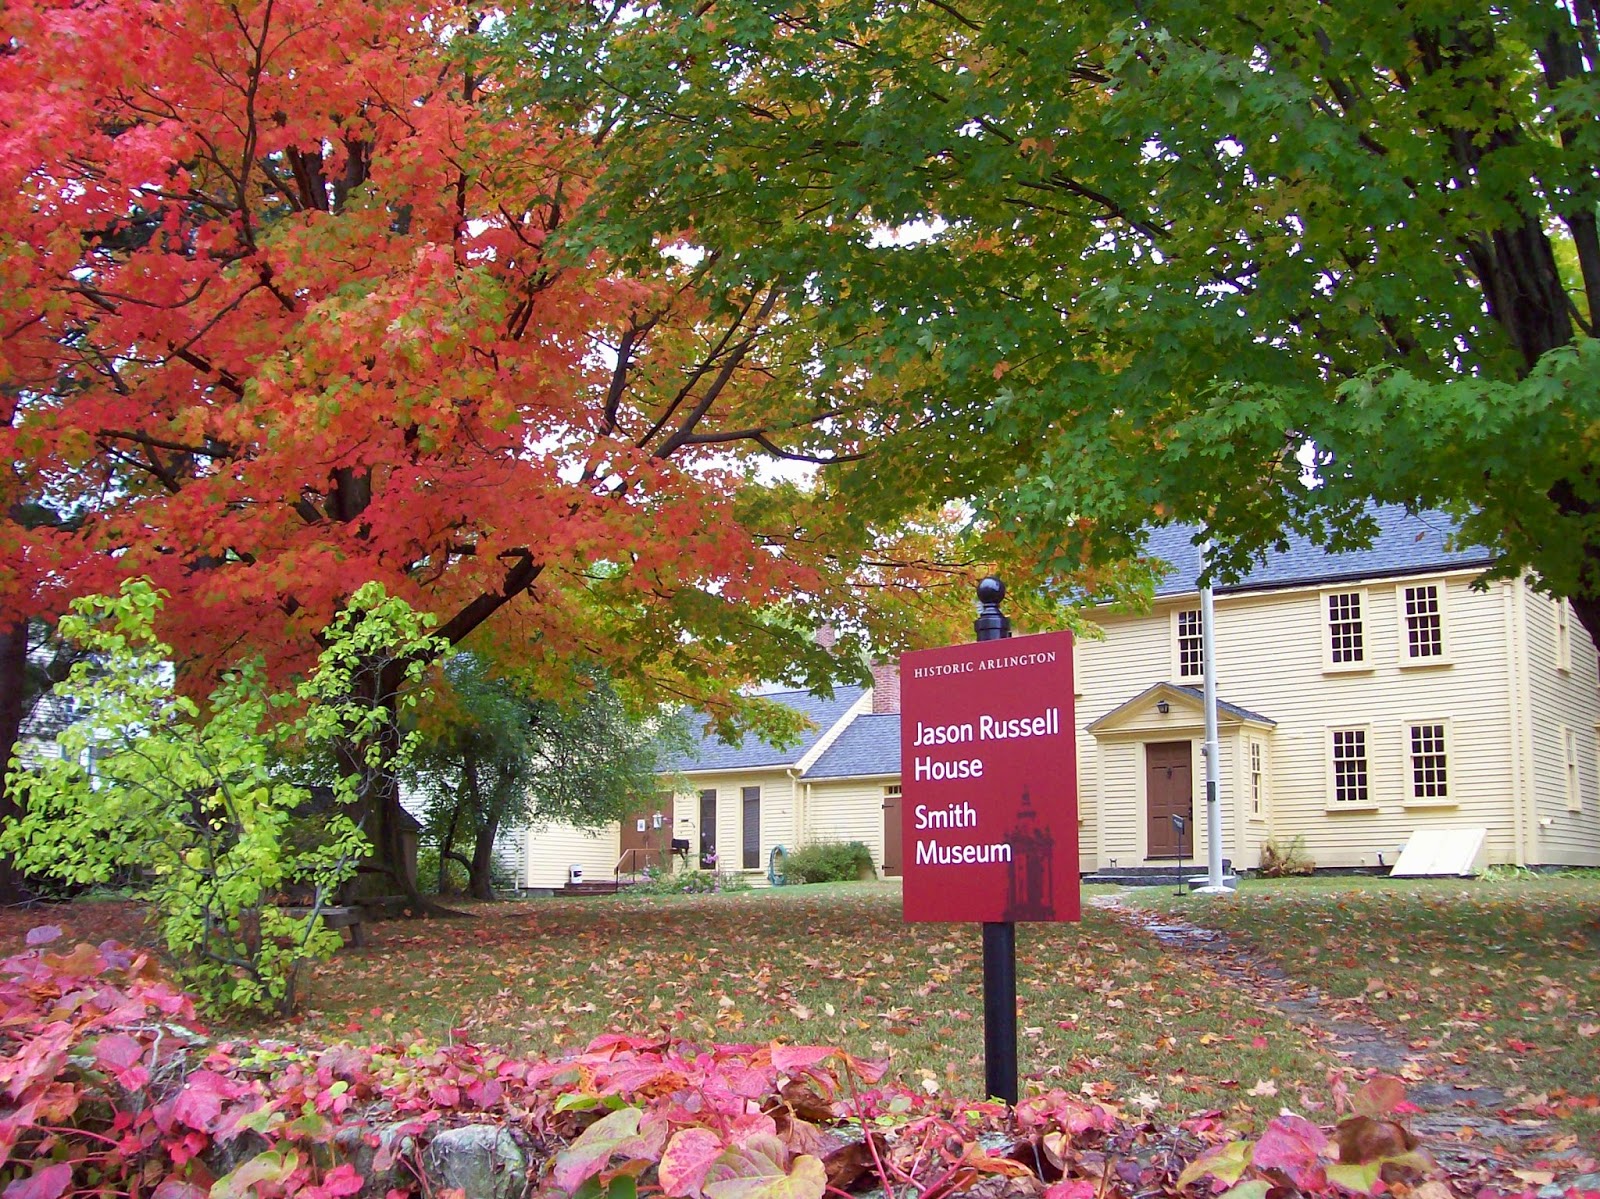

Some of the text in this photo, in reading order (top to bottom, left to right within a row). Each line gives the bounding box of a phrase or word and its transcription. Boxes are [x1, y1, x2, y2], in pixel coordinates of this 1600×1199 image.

[914, 651, 1056, 678] HISTORIC ARLINGTON
[913, 707, 1059, 747] Jason Russell
[914, 756, 983, 781] House
[914, 801, 976, 829] Smith
[915, 839, 1012, 865] Museum
